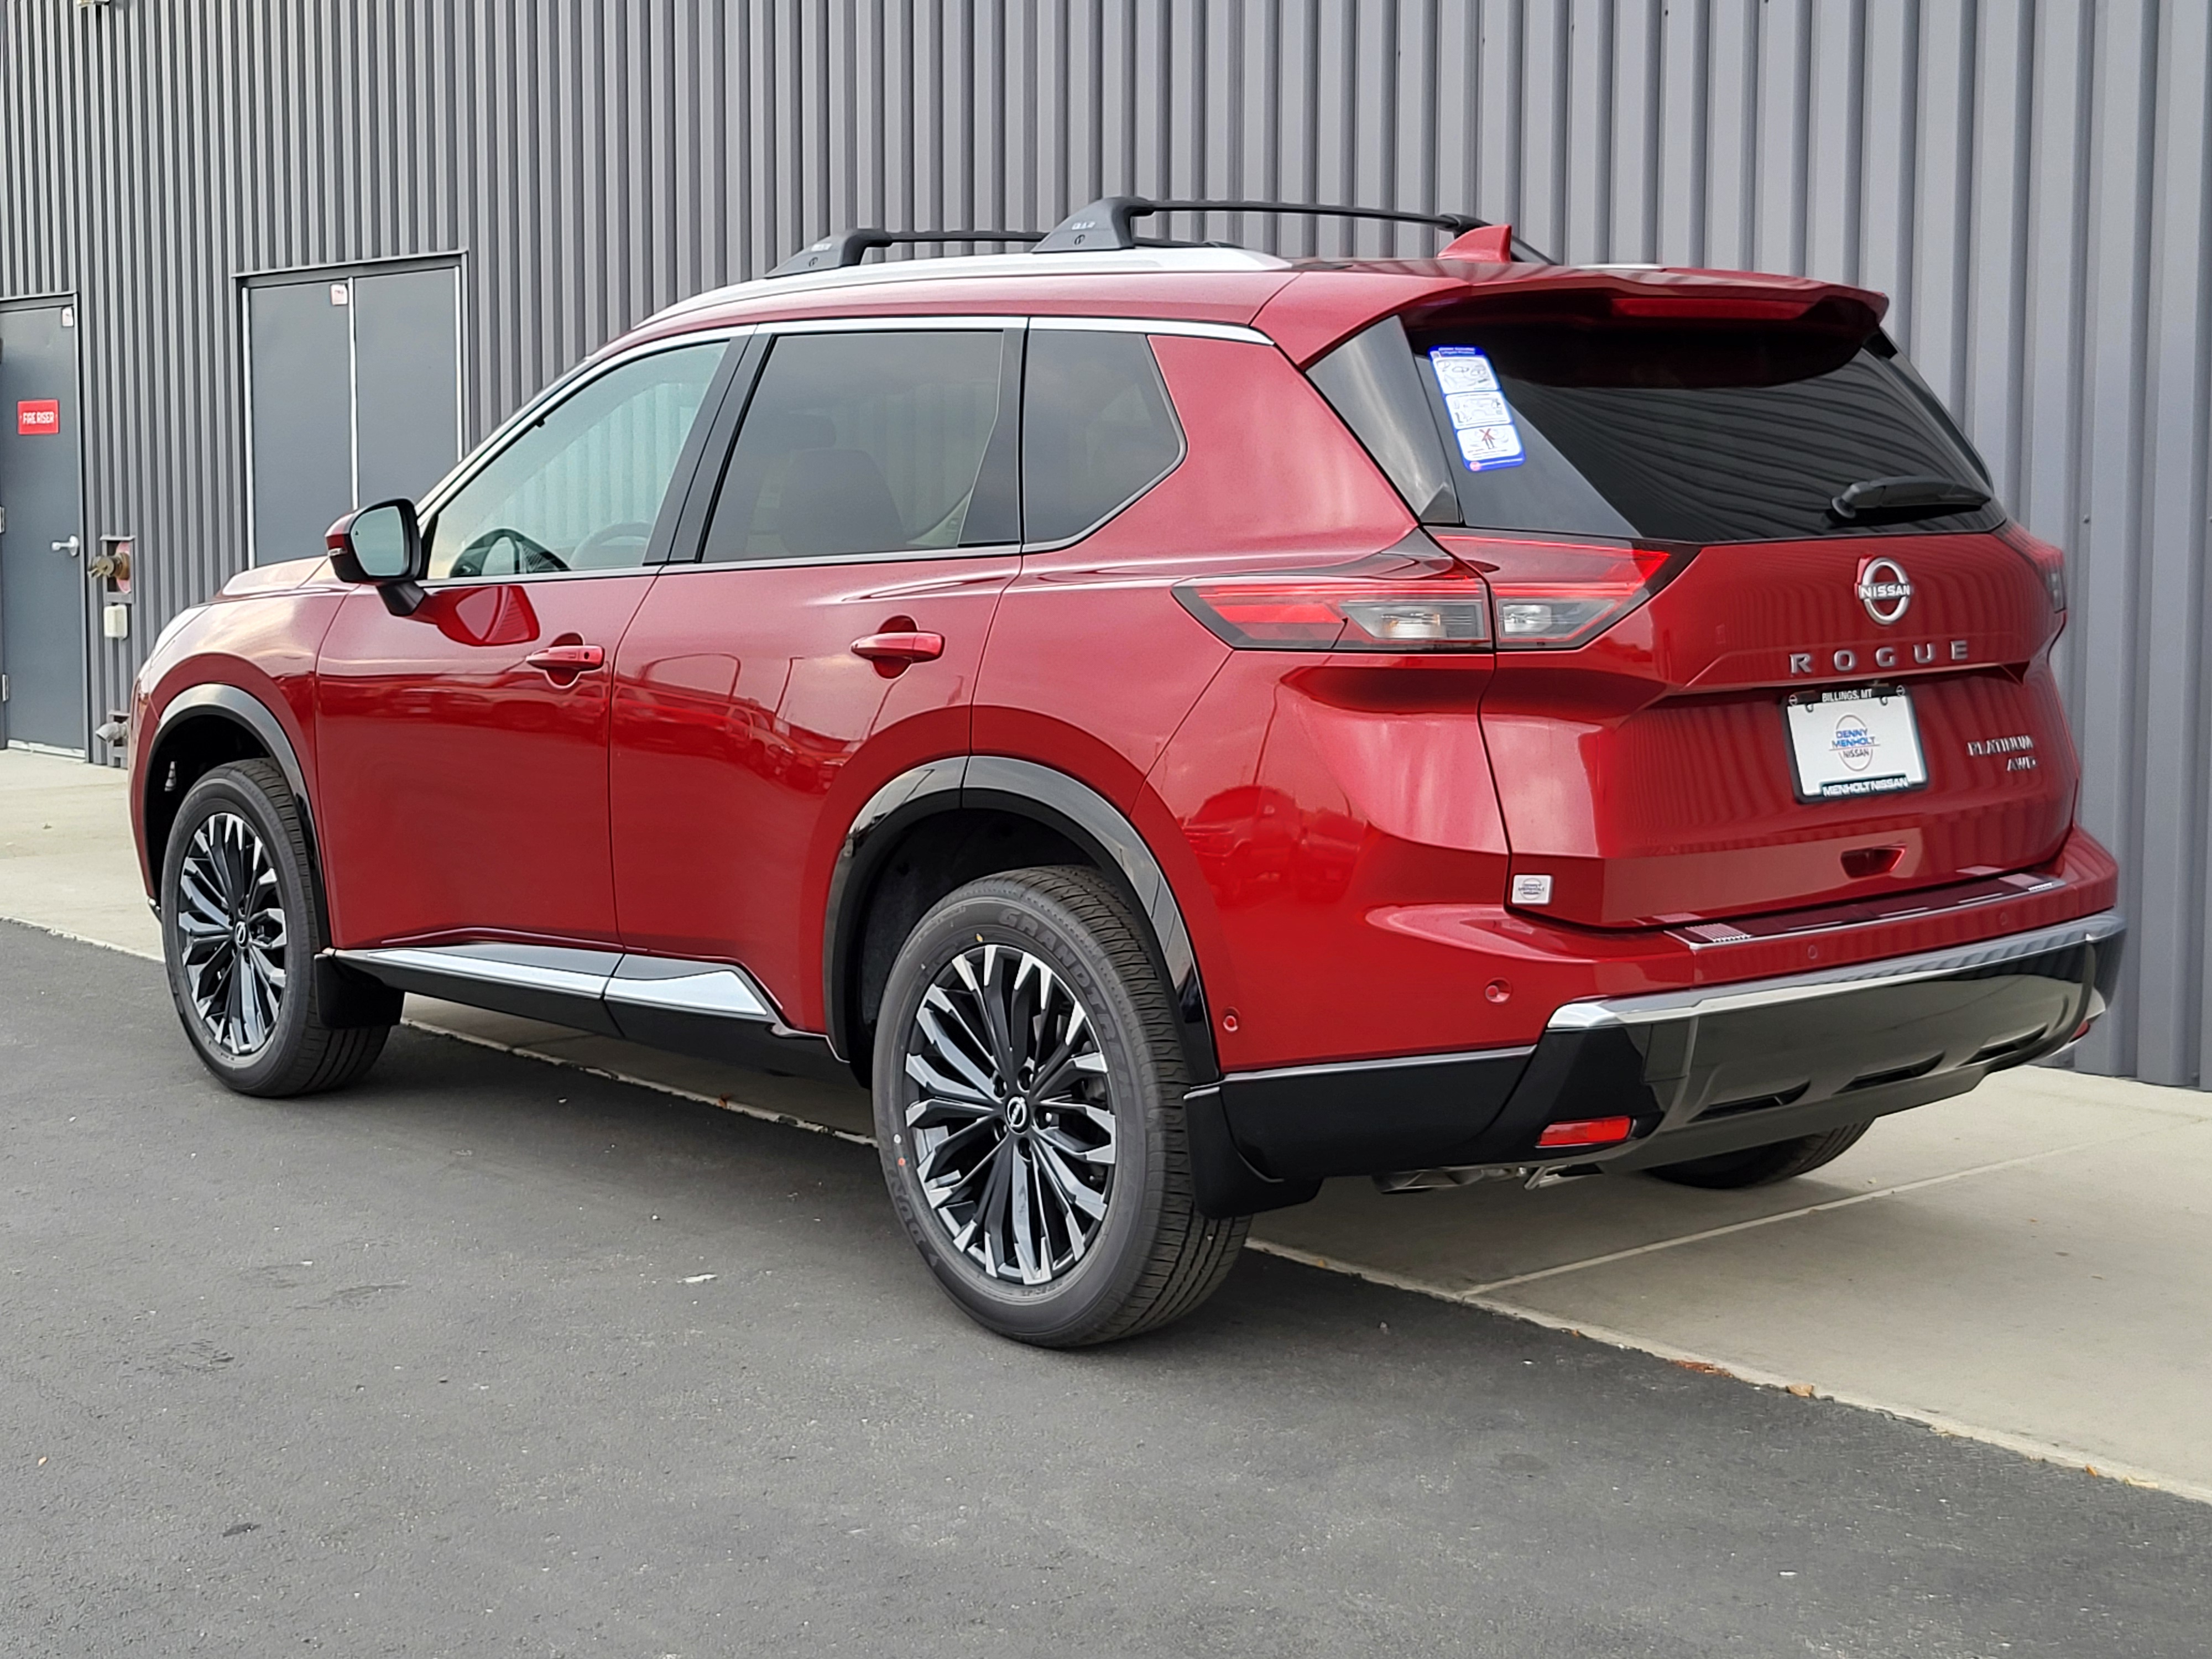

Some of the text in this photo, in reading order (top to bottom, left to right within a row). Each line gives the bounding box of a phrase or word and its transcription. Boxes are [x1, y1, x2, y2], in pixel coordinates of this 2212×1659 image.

[23, 411, 54, 424] FIRE RISER
[1860, 585, 1910, 597] NISSAN
[1790, 640, 1968, 674] ROGUE
[1861, 688, 1872, 698] MT
[1836, 728, 1867, 739] DENNY
[1832, 736, 1875, 749] MENHOLT
[1967, 735, 2033, 756] PLATINUM
[1843, 748, 1869, 758] NISSAN
[2007, 757, 2036, 771] AWD
[1822, 776, 1908, 796] MENHOLT NISSAN
